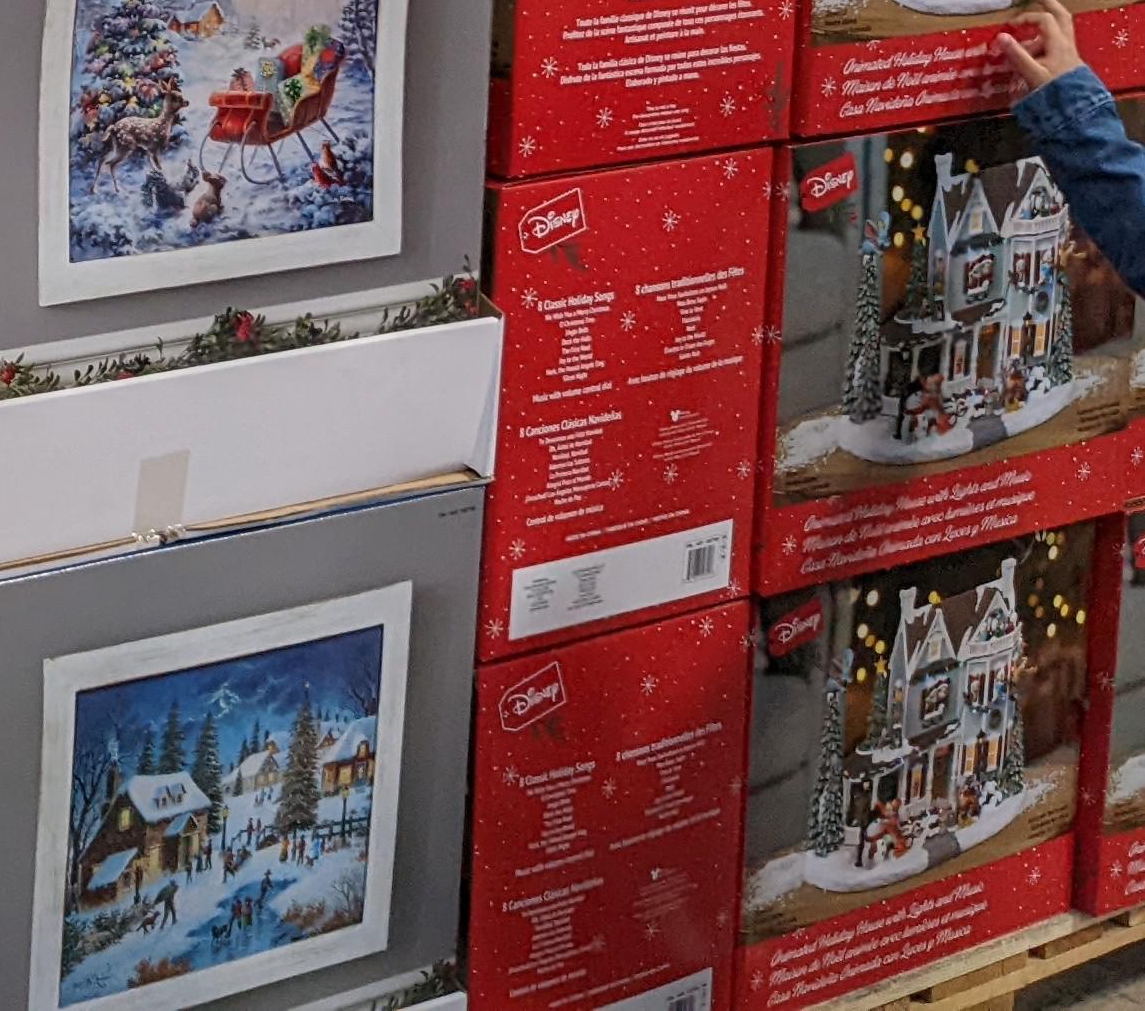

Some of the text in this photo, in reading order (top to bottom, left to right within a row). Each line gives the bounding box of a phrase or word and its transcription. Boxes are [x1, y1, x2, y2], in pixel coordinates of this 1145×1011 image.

[807, 170, 855, 198] Disney
[528, 208, 580, 238] Disney
[775, 613, 821, 644] Disney
[508, 680, 560, 715] Disney
